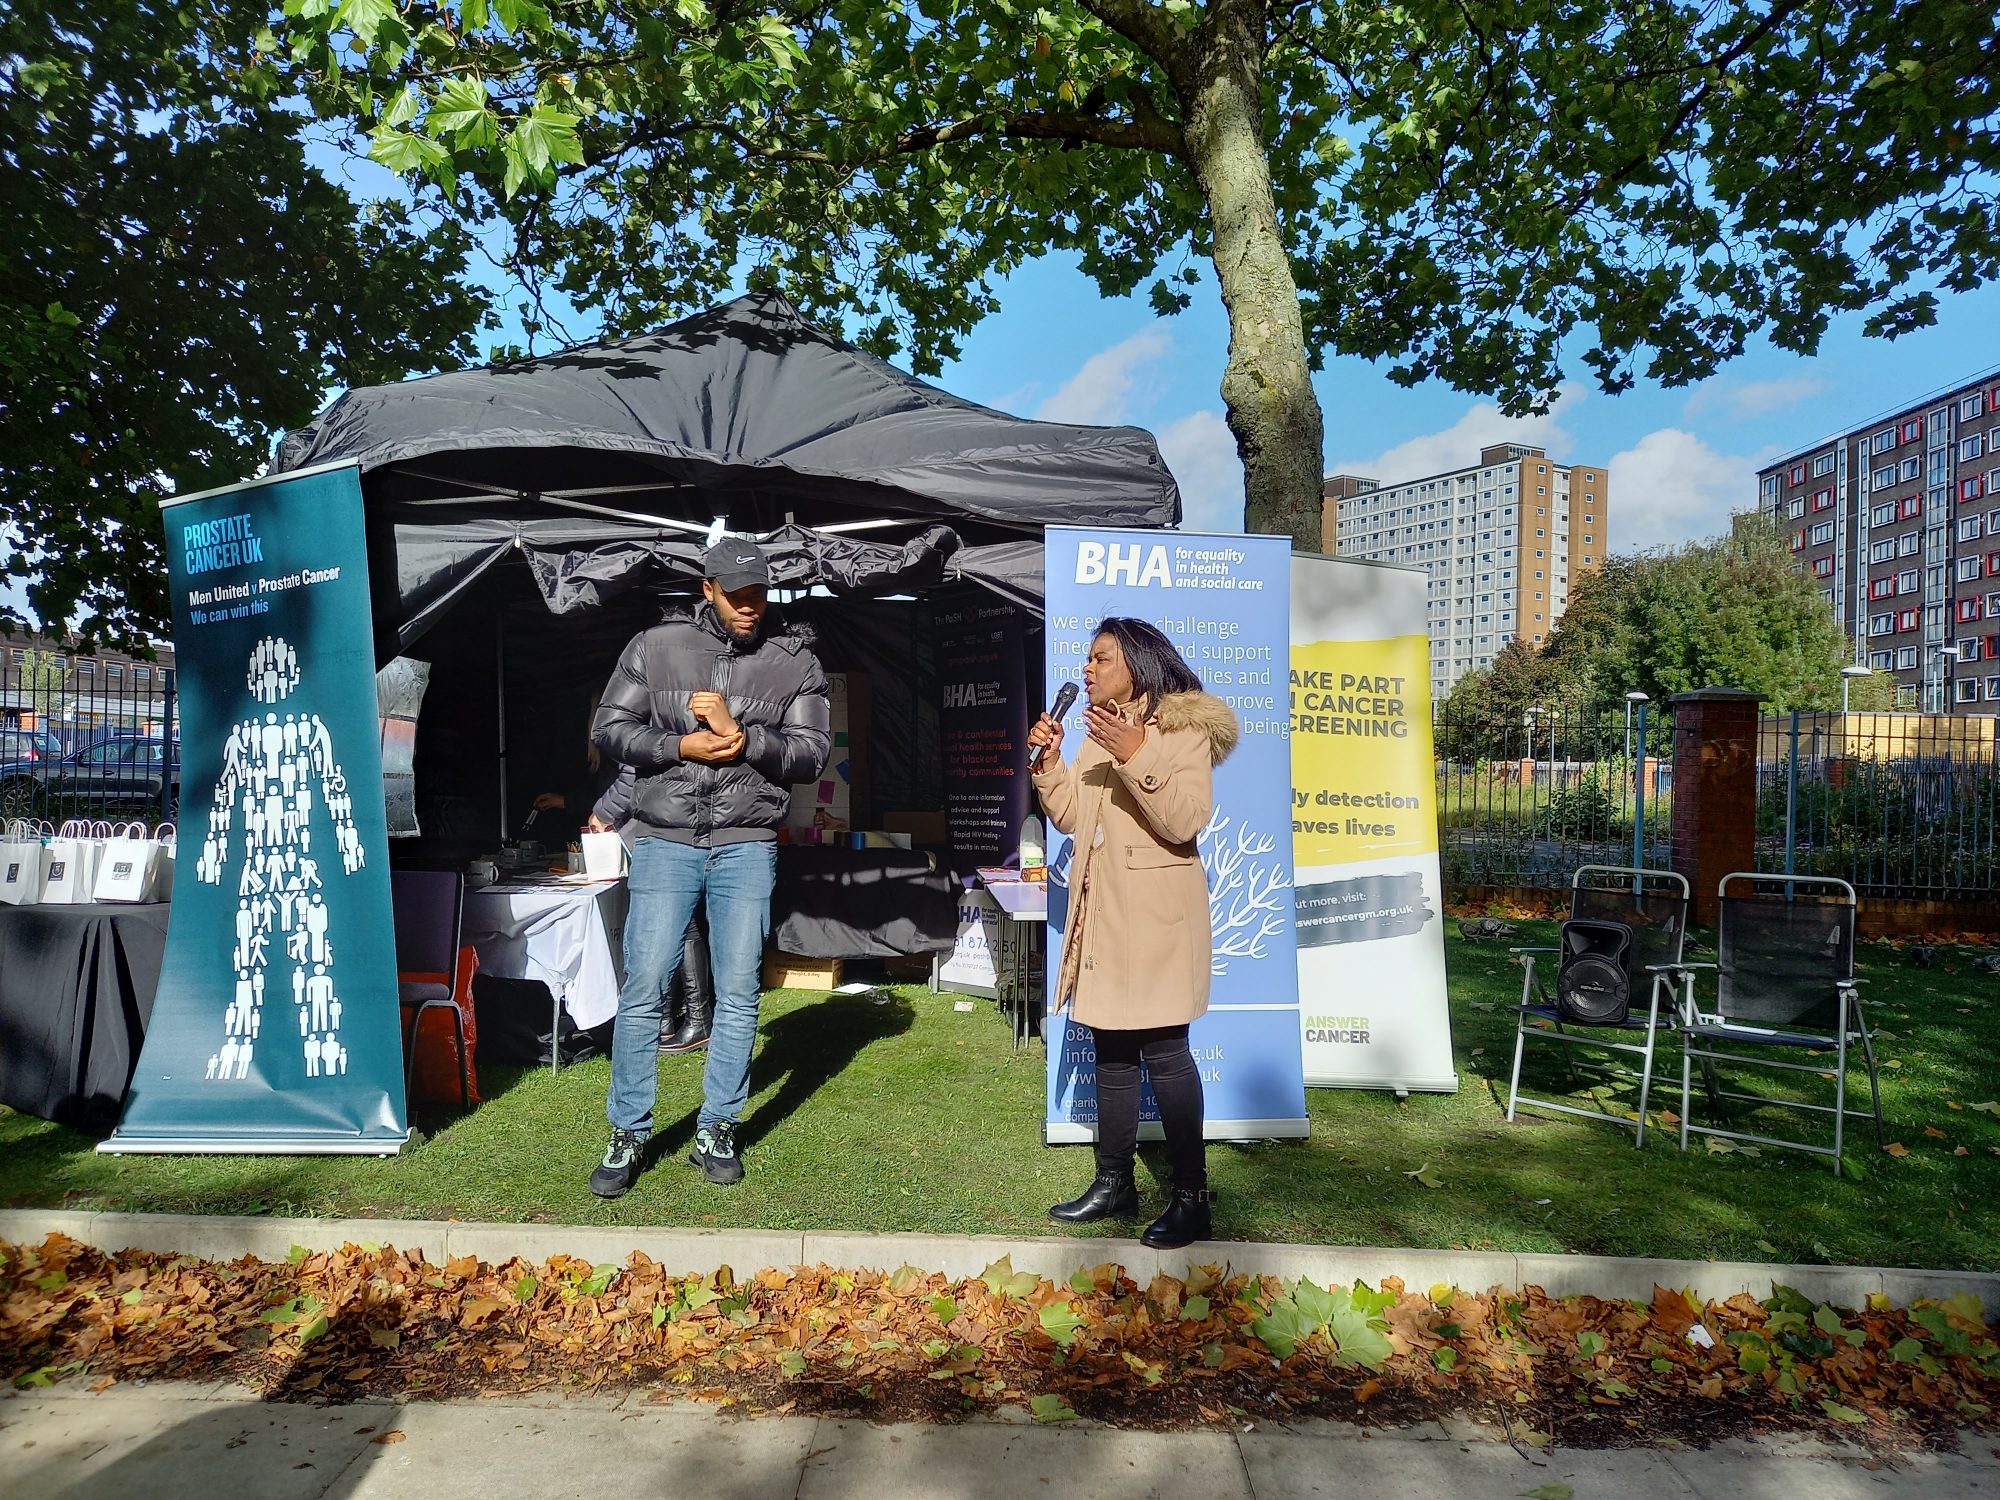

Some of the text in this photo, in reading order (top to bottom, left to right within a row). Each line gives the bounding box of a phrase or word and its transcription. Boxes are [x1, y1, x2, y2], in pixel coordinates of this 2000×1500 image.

[183, 513, 253, 550] PROSTATE
[185, 537, 264, 575] CANCER UK
[1175, 546, 1246, 564] for equality
[1074, 541, 1173, 589] BHA
[1175, 560, 1229, 575] in health
[189, 566, 341, 607] Men United v Prostate Cancer
[1175, 575, 1264, 590] and social care
[190, 599, 269, 625] We can win this
[1053, 616, 1079, 630] we
[1154, 615, 1239, 639] challenge
[1175, 641, 1196, 659] nd
[1201, 645, 1272, 664] support
[1197, 666, 1232, 684] ilies
[1238, 667, 1270, 685] and
[1289, 669, 1406, 695] AKE PART
[944, 683, 977, 708] BHA
[1225, 695, 1274, 710] prove
[1303, 692, 1404, 717] CANCER
[1243, 716, 1290, 740] being
[1289, 713, 1408, 739] CREENING
[1315, 790, 1419, 809] detection
[982, 806, 999, 815] support
[953, 830, 970, 839] Rapid
[1292, 818, 1396, 837] aves lives
[953, 843, 972, 851] results
[1295, 899, 1308, 909] ut
[1341, 891, 1367, 903] visit:
[960, 905, 981, 924] HA
[1295, 904, 1414, 928] swercancergm.org.uk
[968, 936, 990, 949] 874
[1305, 1015, 1370, 1030] ANSWER
[1305, 1029, 1370, 1044] CANCER
[1064, 1096, 1098, 1111] charity
[1064, 1111, 1099, 1122] compa
